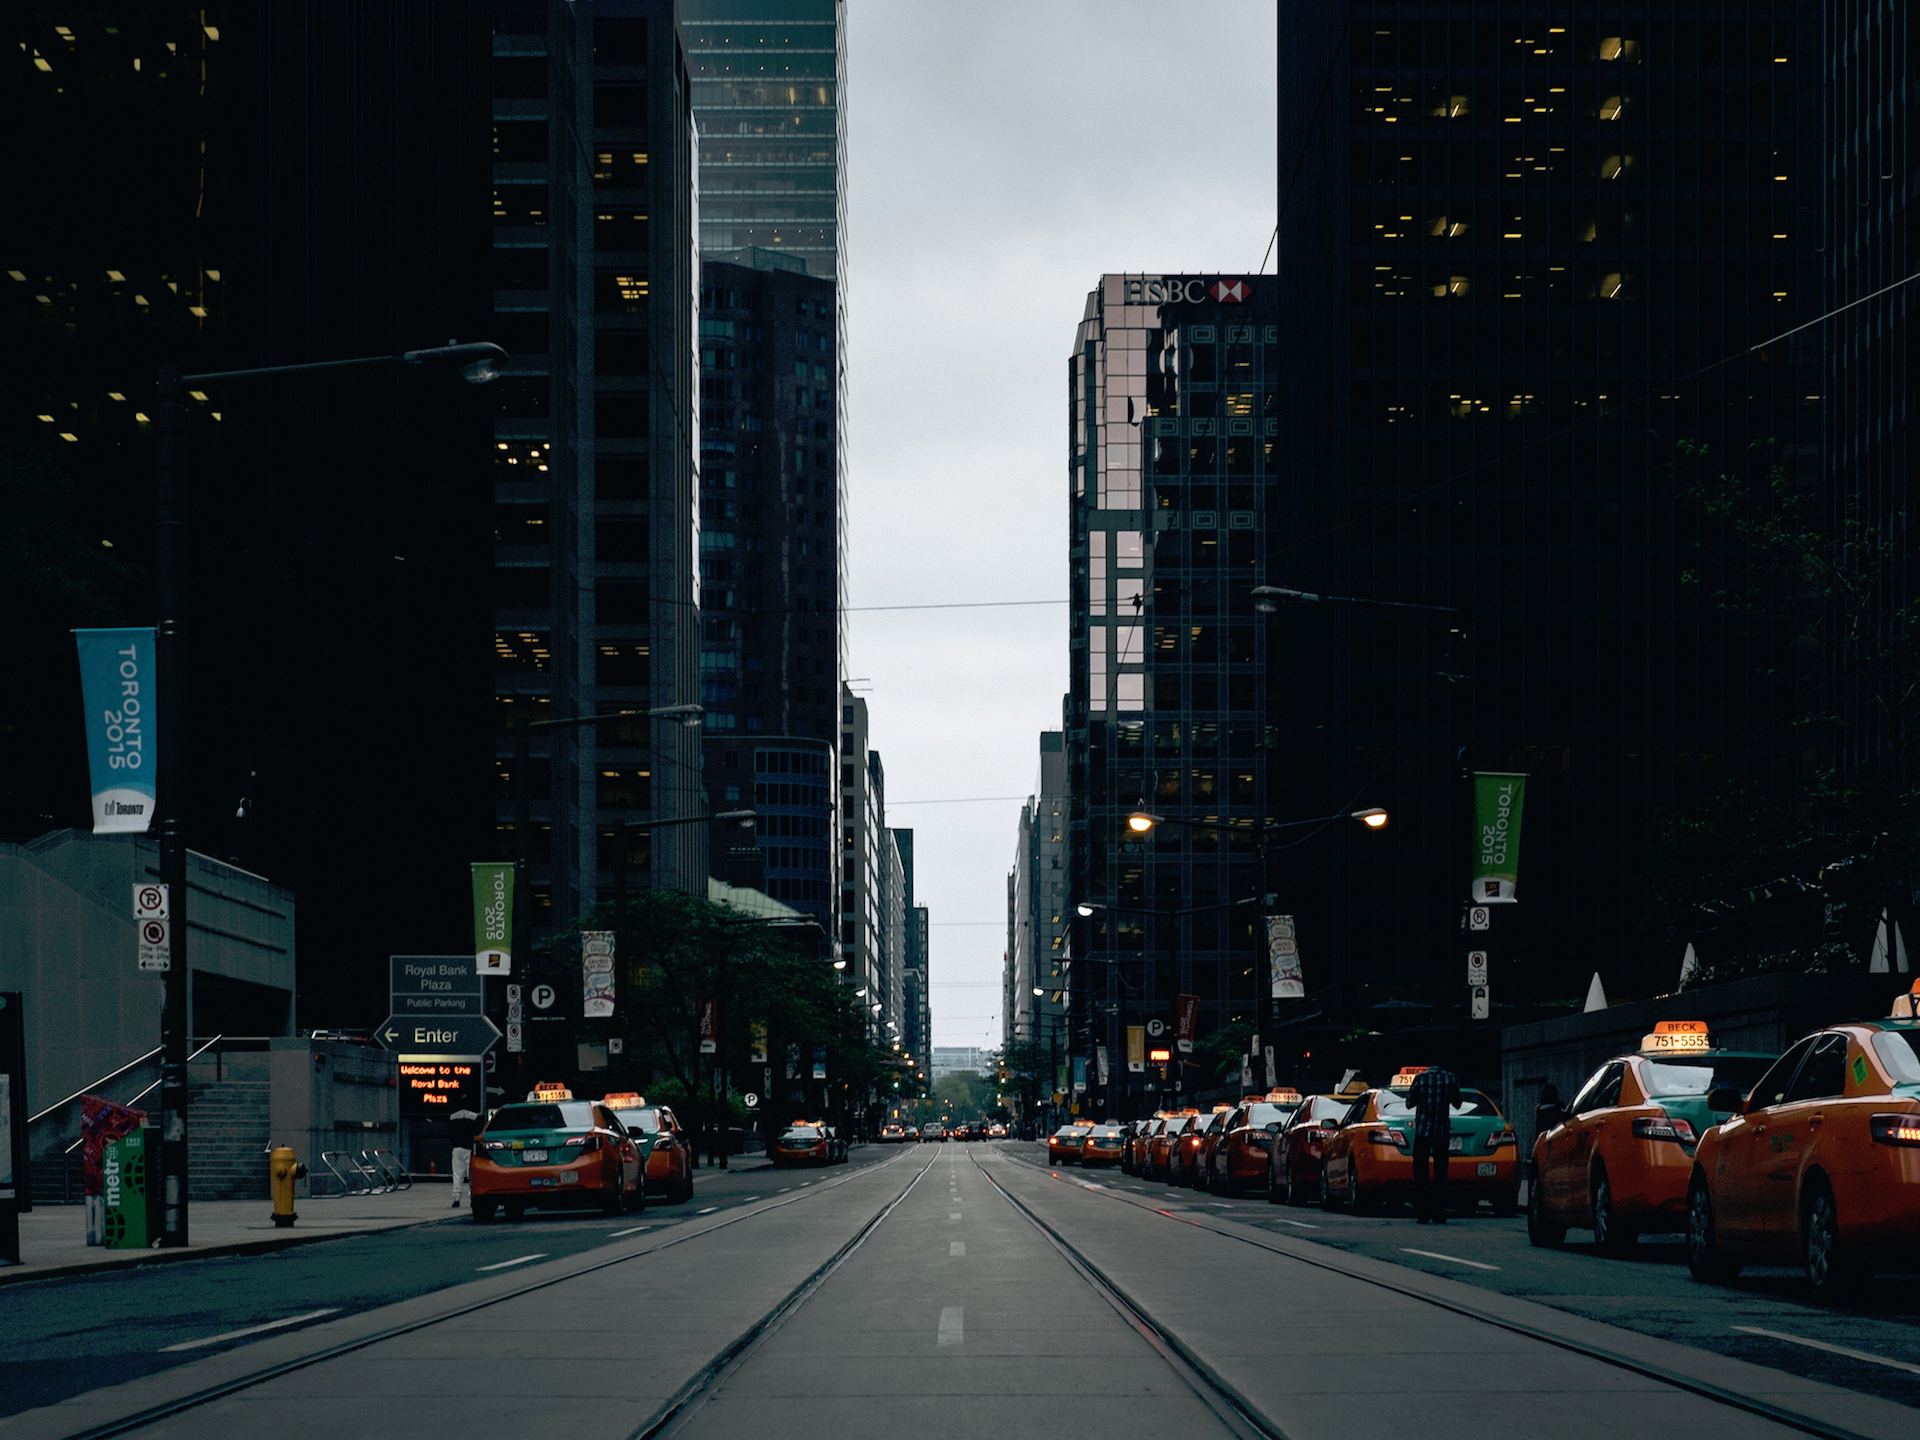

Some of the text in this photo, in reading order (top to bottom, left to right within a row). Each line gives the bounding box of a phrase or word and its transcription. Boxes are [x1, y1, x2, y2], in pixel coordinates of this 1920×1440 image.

[1124, 279, 1206, 304] HSBC
[118, 644, 142, 770] TORONTO
[104, 710, 126, 769] 2015
[1493, 783, 1512, 865] TORONTO
[1481, 825, 1496, 864] 2015
[494, 872, 505, 940] TORONTO
[485, 907, 496, 940] 2015
[405, 964, 467, 977] Royal Bank
[420, 979, 451, 990] Plaza
[538, 988, 551, 1005] P
[407, 999, 466, 1009] Public Parking
[1152, 1022, 1161, 1034] P
[1668, 1023, 1696, 1032] BECK
[414, 1027, 458, 1043] Enter
[1654, 1035, 1709, 1047] 751-5555
[400, 1065, 471, 1075] Welcome to the
[411, 1079, 460, 1089] Royal Bank
[423, 1093, 449, 1103] Plaza
